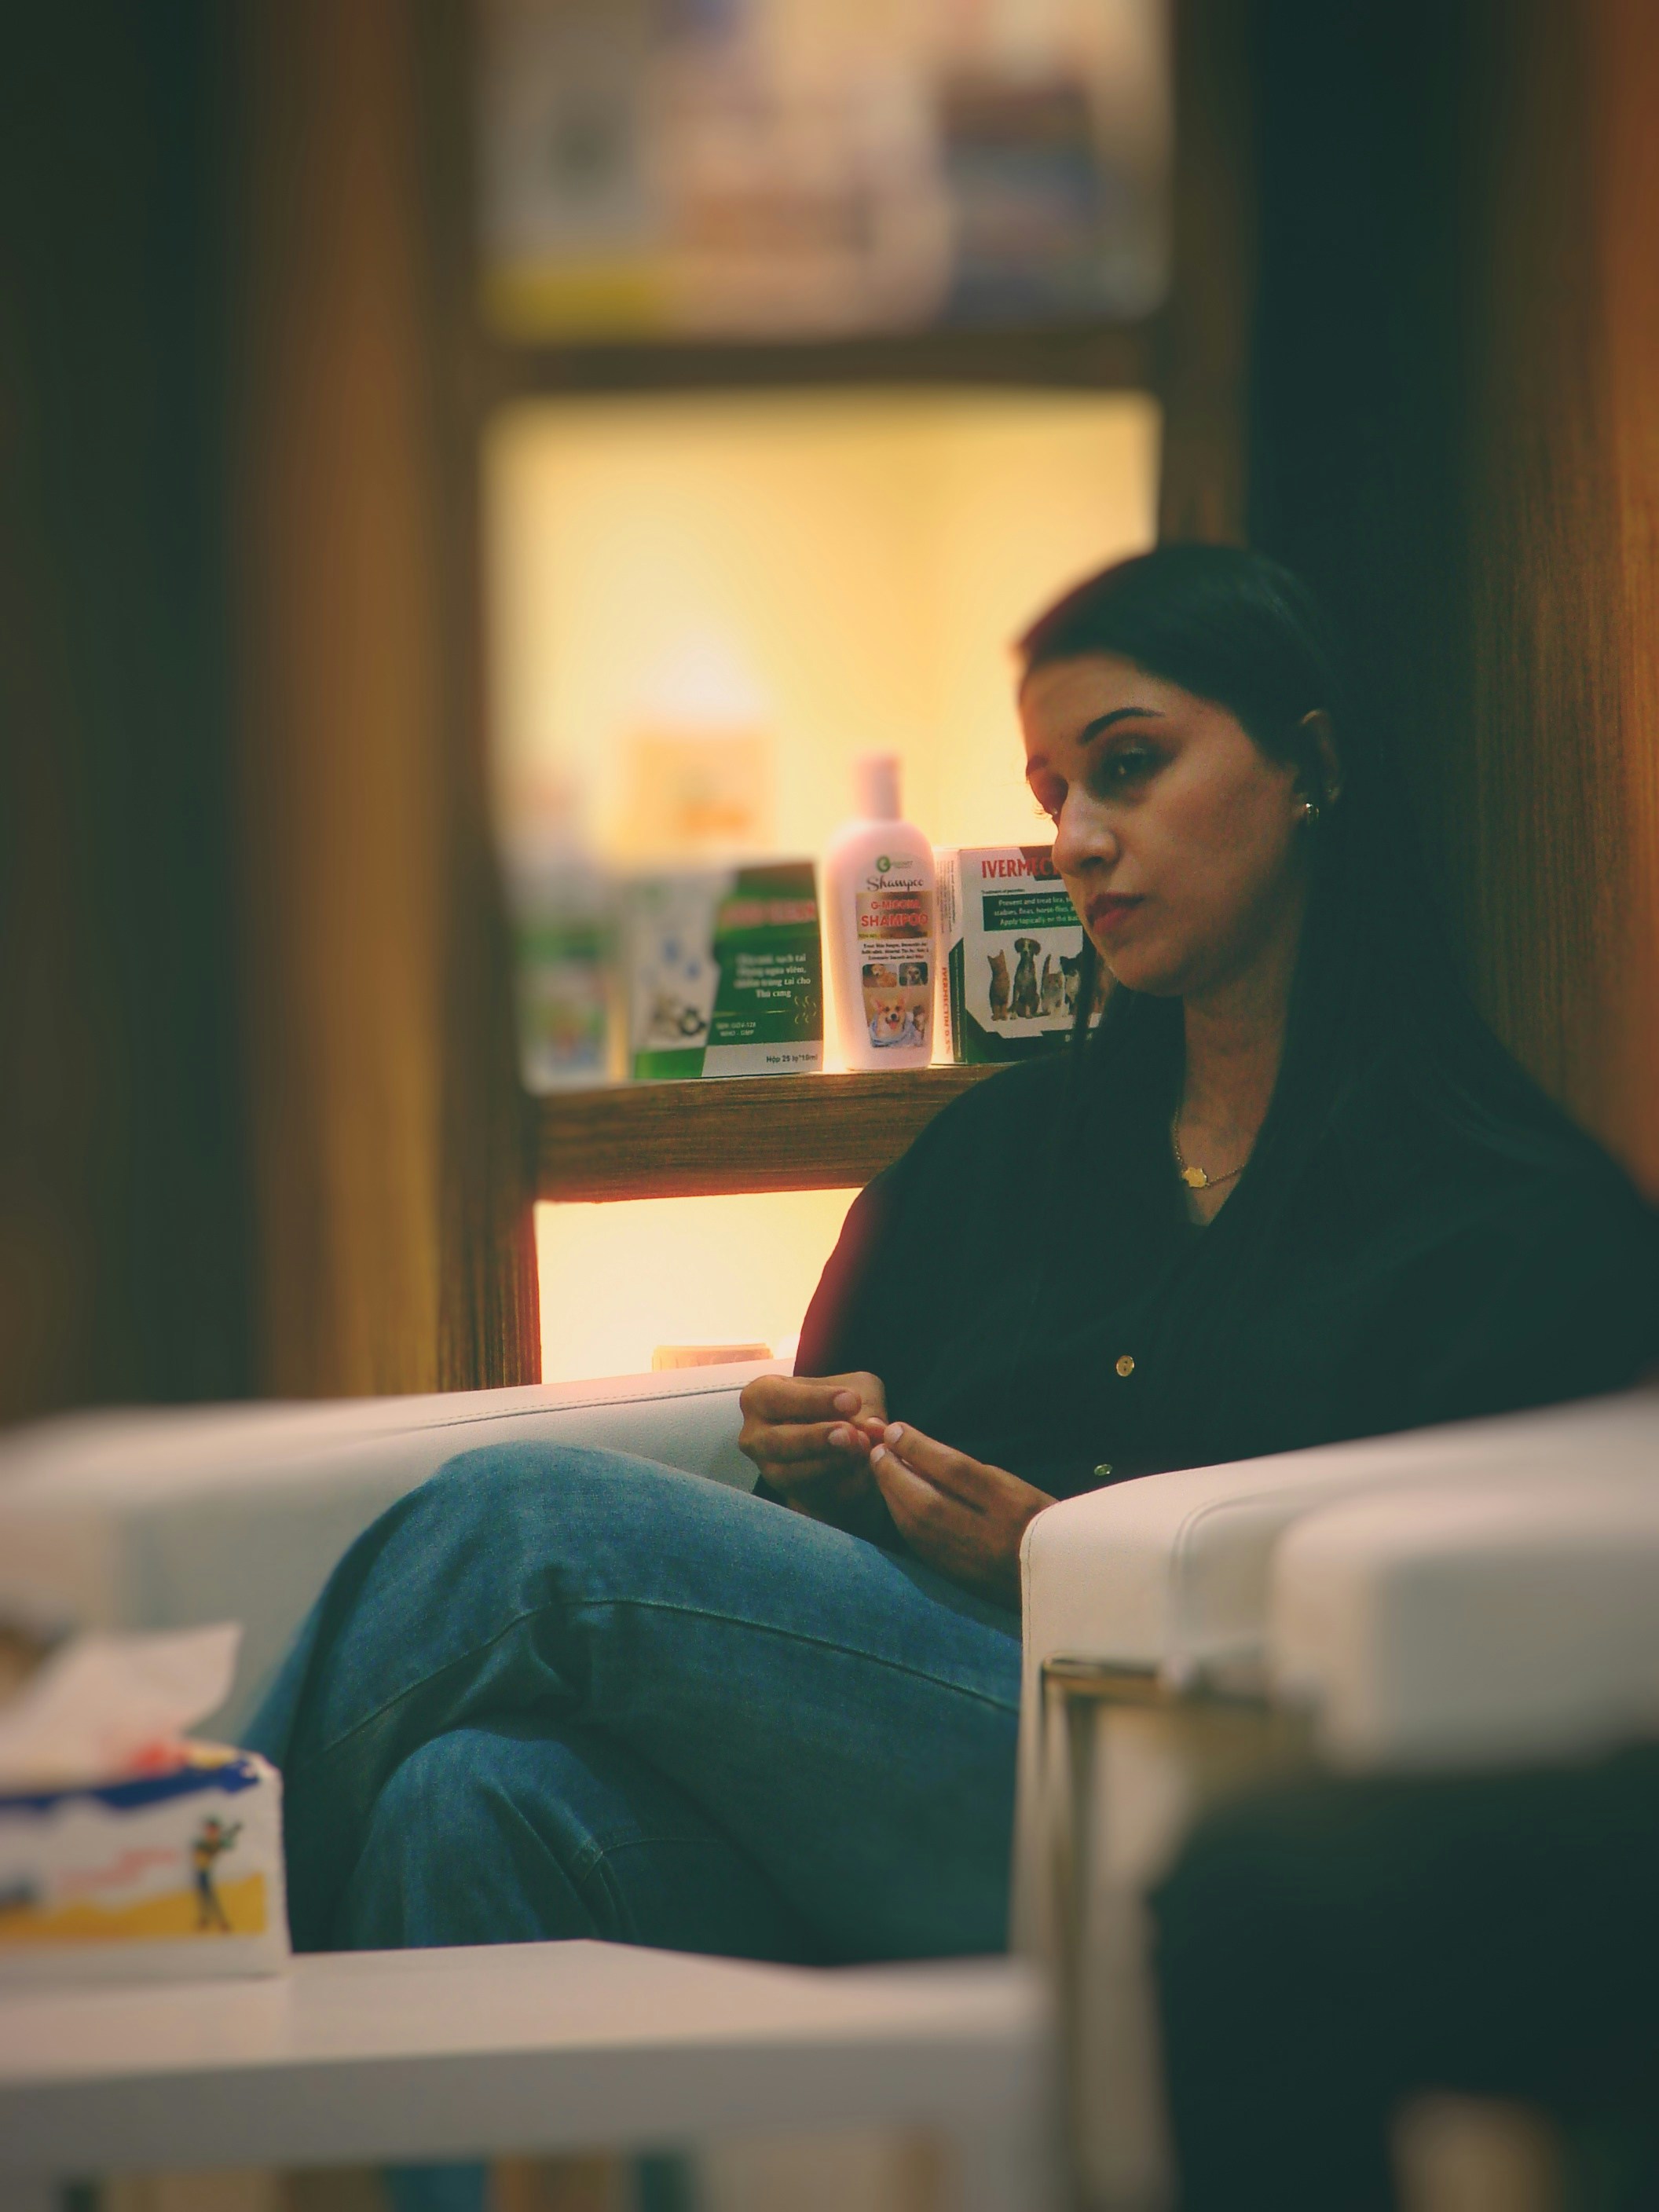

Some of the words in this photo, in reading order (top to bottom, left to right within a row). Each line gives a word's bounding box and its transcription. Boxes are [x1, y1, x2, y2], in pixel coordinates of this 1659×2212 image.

[982, 857, 1059, 878] IVERMEC
[861, 913, 928, 927] SHAMPOO
[795, 954, 807, 962] tai
